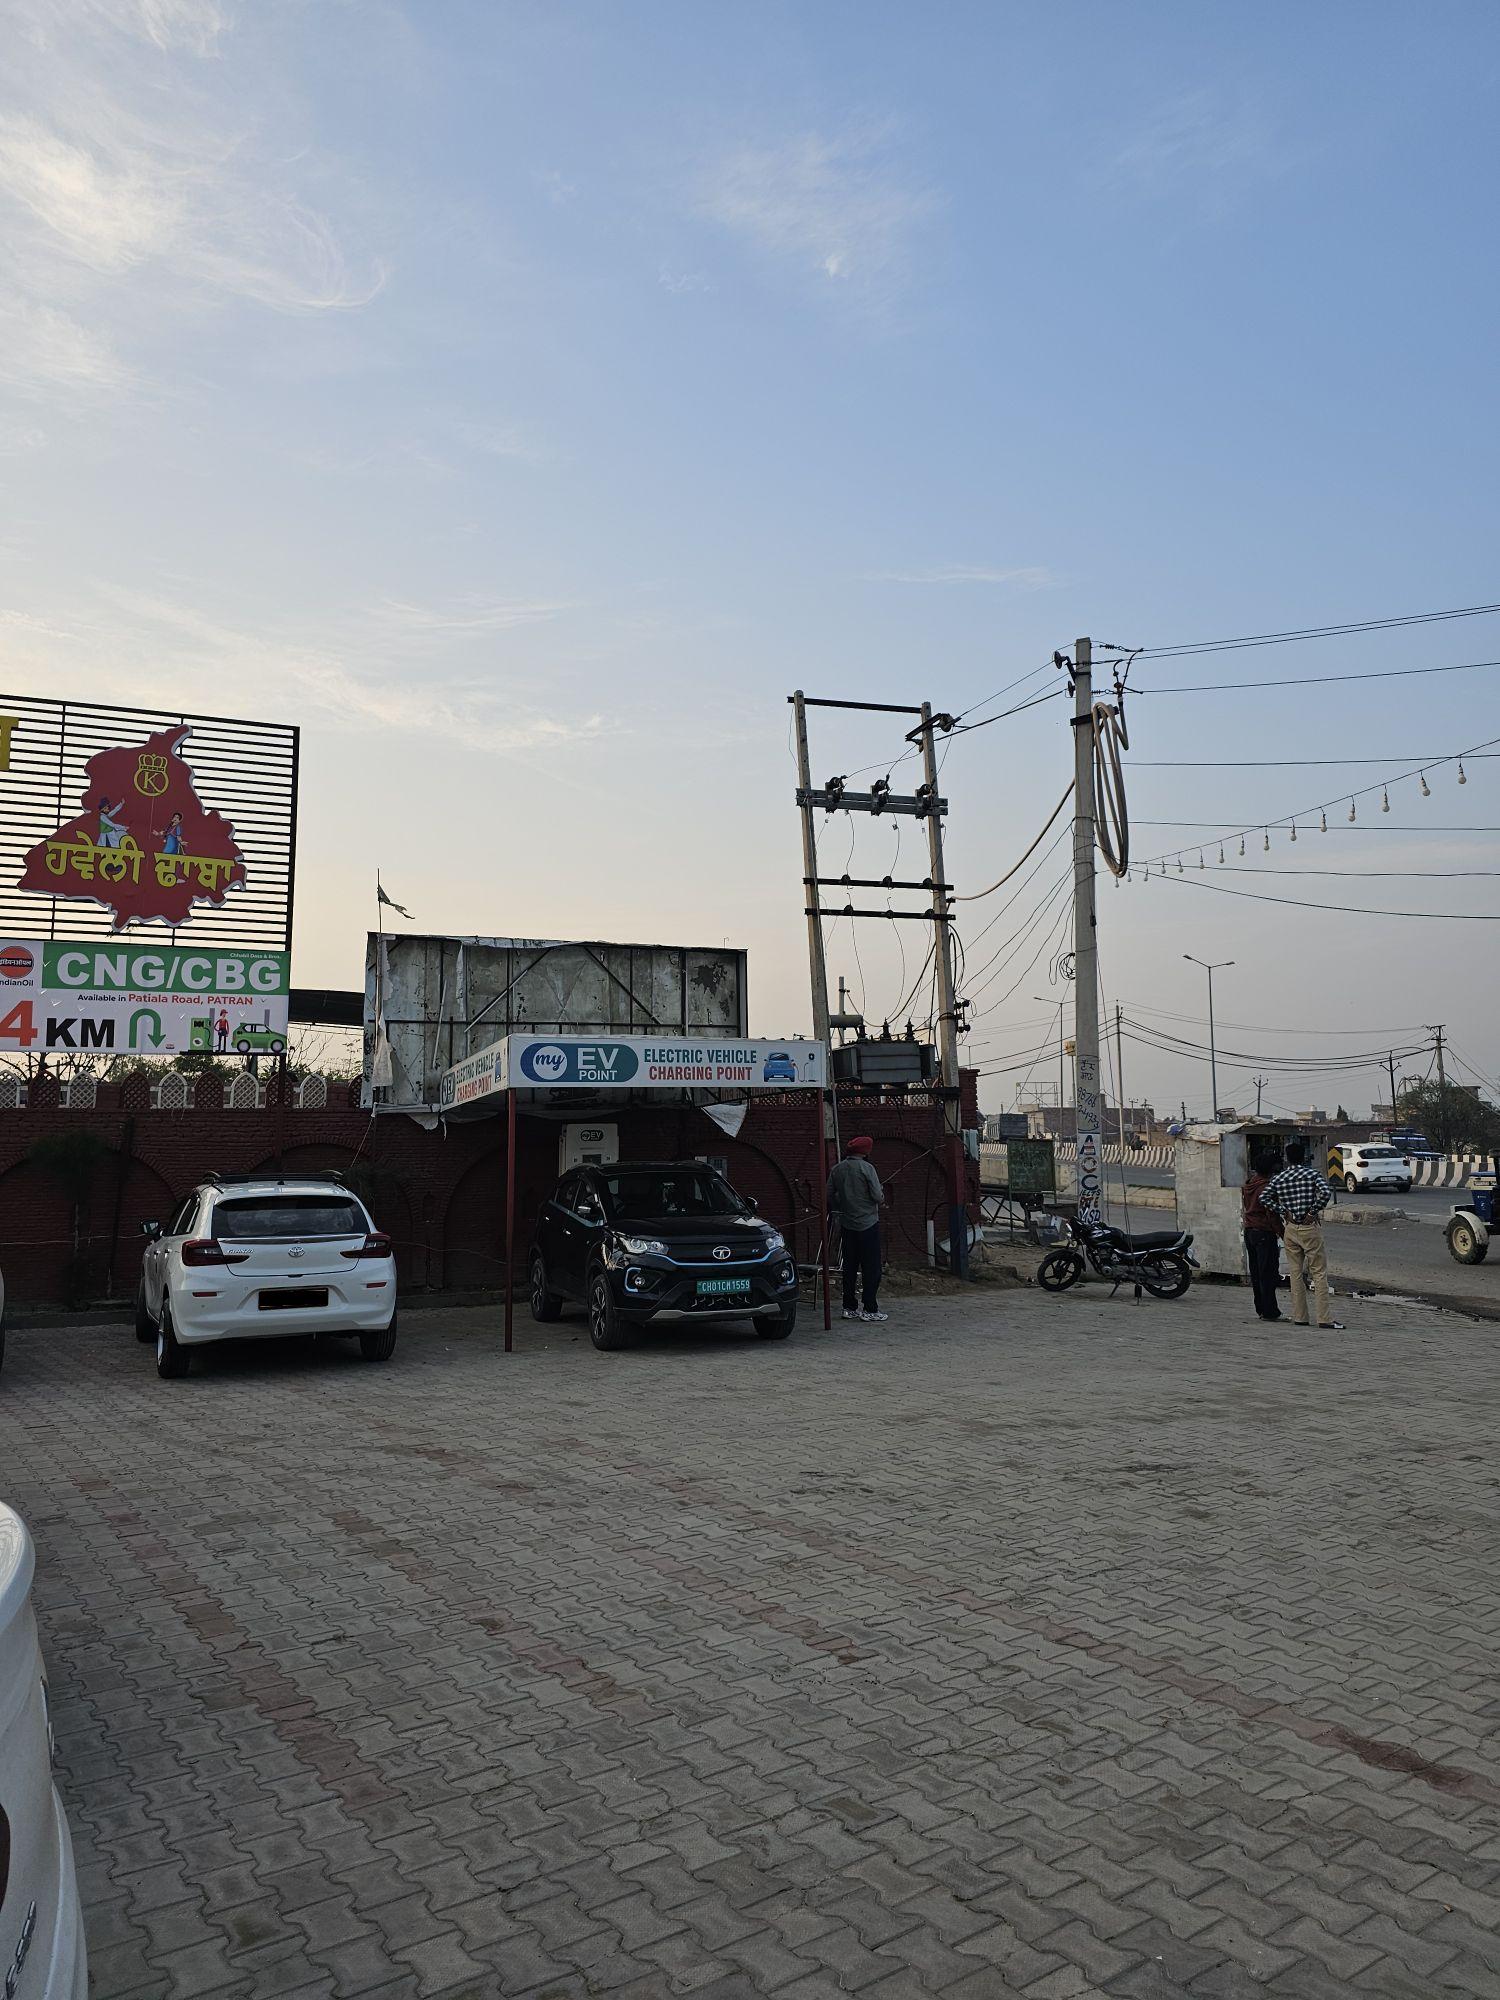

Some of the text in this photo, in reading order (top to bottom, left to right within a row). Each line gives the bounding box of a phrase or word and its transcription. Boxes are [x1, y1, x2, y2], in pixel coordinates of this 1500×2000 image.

[45, 830, 236, 891] ਹਵੇਲੀ ਢਾਬਾ
[57, 952, 281, 991] CNG/CBG
[77, 994, 116, 1002] Available
[128, 993, 168, 1003] Patiala
[171, 995, 205, 1005] Road,
[207, 996, 253, 1005] PATRAN
[0, 1000, 115, 1048] 4 KM
[535, 1049, 566, 1073] my
[577, 1048, 619, 1069] EV
[644, 1049, 757, 1063] ELECTRIC VEHICLE
[456, 1052, 494, 1084] ELECTRIC VEHICLE
[580, 1070, 617, 1081] POINT
[649, 1067, 752, 1080] CHARGING POINT
[457, 1080, 477, 1102] CHARGING
[478, 1074, 492, 1094] POINT
[1079, 1189, 1102, 1197] IELTS
[702, 1280, 750, 1291] CH01CM1559
